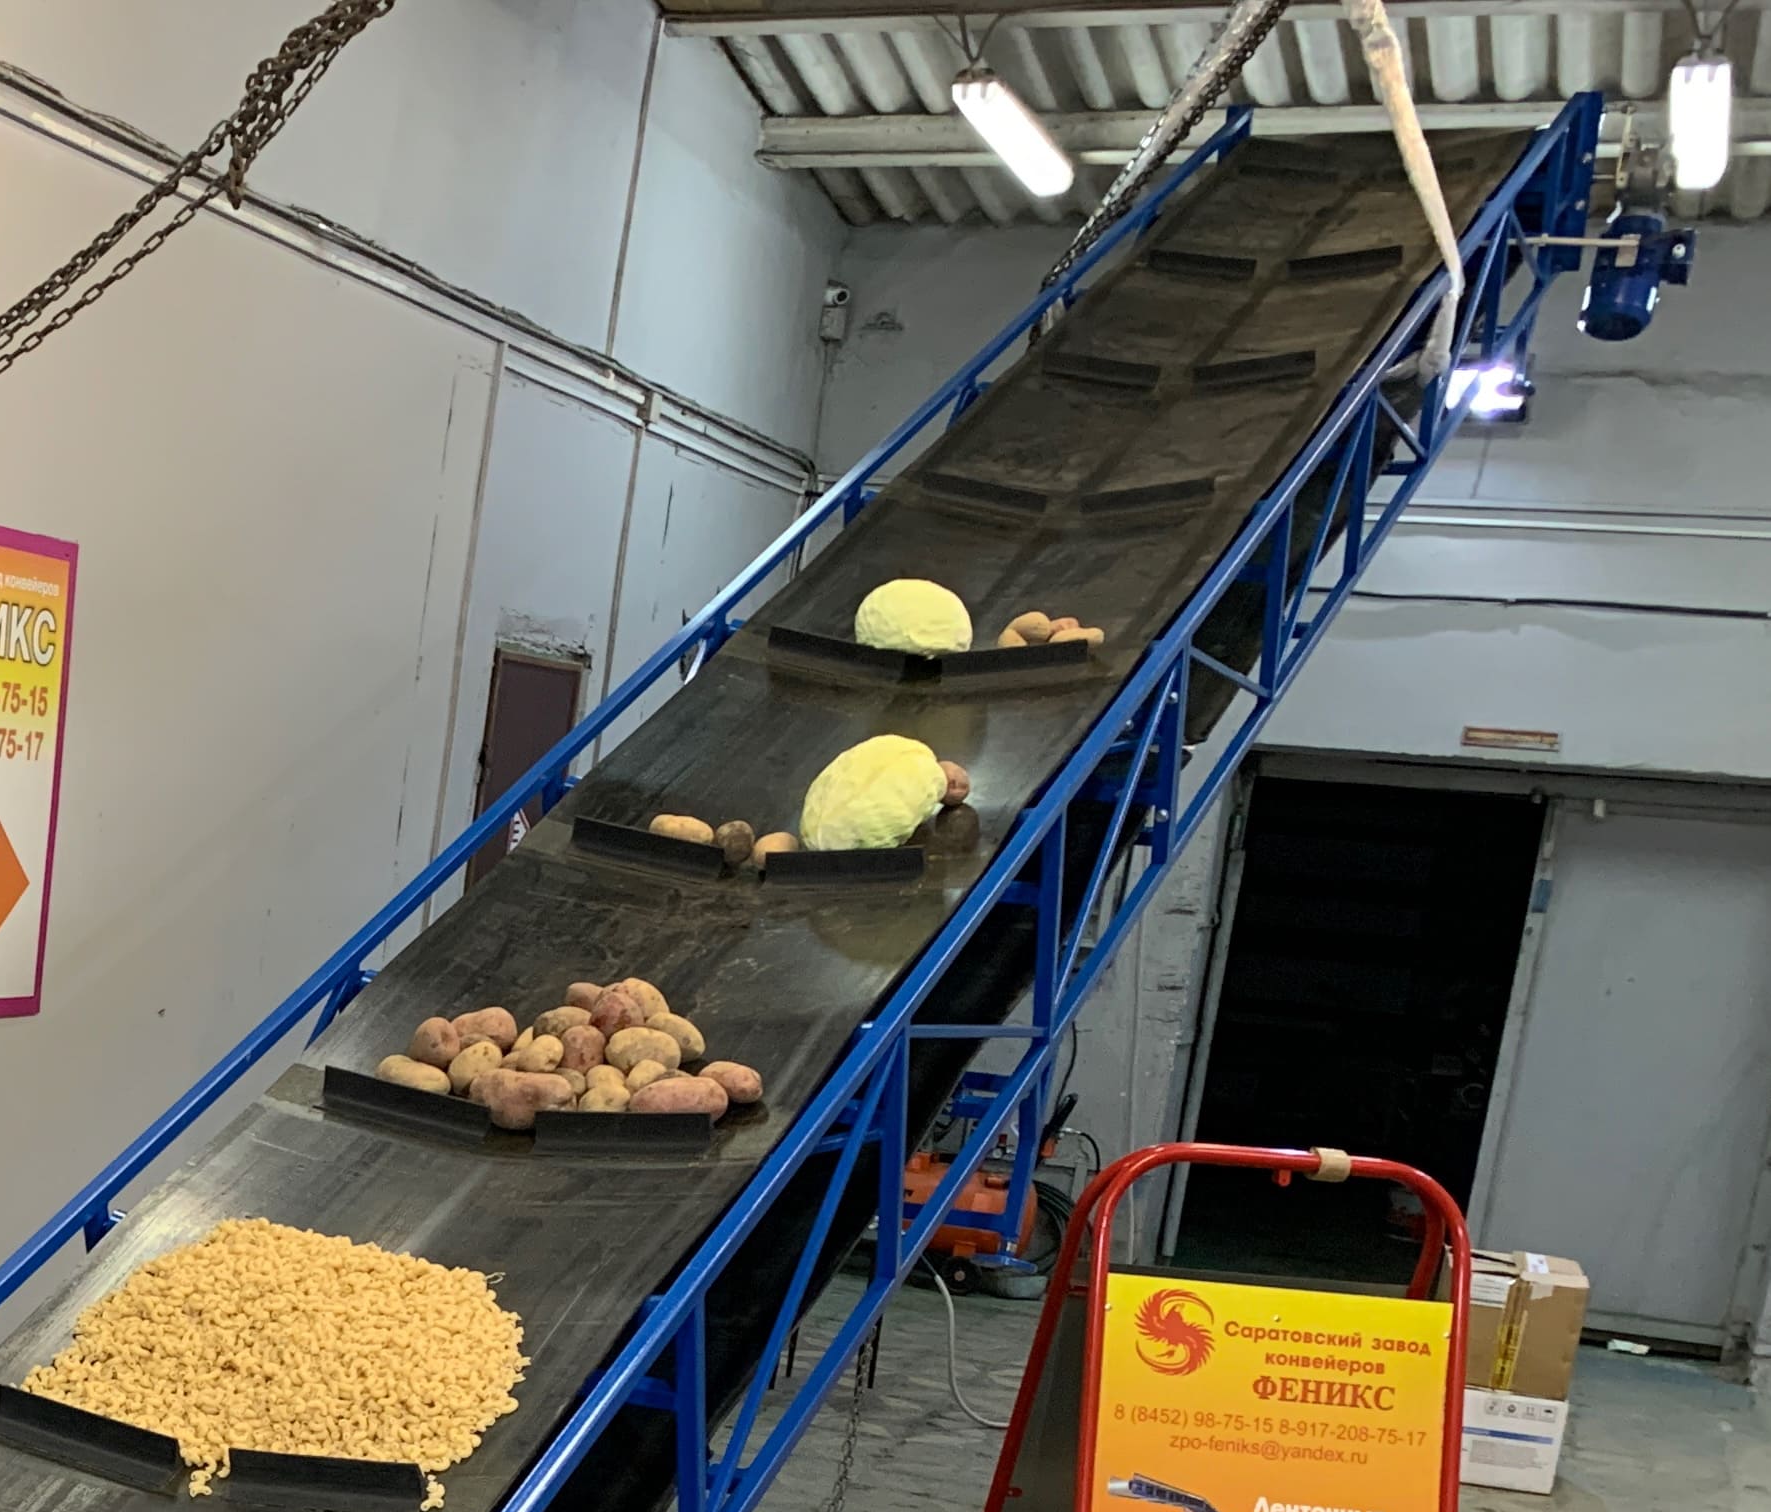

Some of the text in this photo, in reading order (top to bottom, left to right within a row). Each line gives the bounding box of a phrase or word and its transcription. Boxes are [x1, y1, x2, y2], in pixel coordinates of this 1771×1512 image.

[1224, 1320, 1431, 1357] Саратовский завод
[1264, 1351, 1385, 1377] конвейеров
[1252, 1375, 1396, 1411] ФЕНИКС
[1113, 1404, 1427, 1447] 8 (8452) 98-75-15 8-917-208-75-17
[1169, 1432, 1368, 1465] zpo-feniks@yandex.ru
